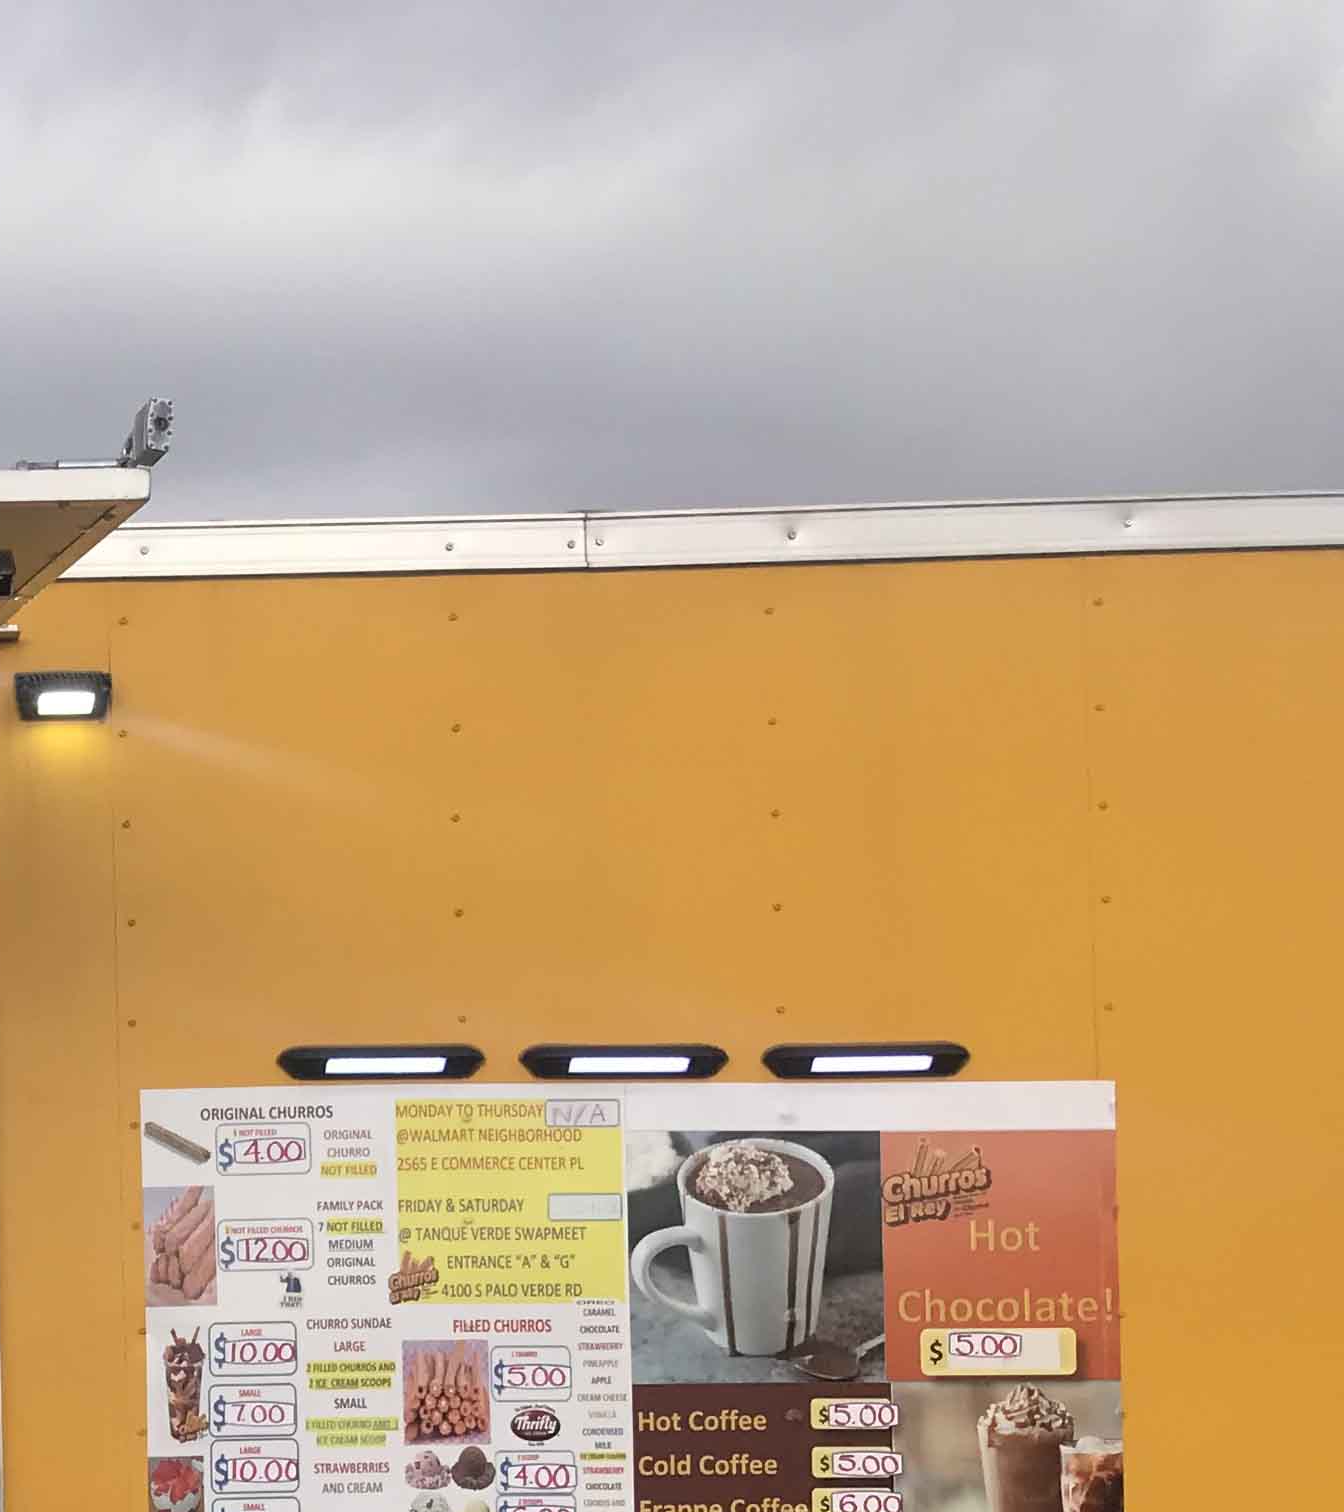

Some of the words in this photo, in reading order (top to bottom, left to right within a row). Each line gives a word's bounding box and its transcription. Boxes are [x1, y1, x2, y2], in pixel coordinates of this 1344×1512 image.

[200, 1107, 265, 1121] ORIGINAL
[269, 1105, 333, 1119] CHURROS
[396, 1105, 452, 1118] MONDAY
[457, 1105, 473, 1118] TO
[478, 1104, 544, 1118] THURSDAY
[552, 1104, 607, 1125] N/A
[323, 1130, 372, 1140] ORIGINAL
[397, 1129, 475, 1144] @WALMART
[479, 1129, 582, 1142] NEIGHBORHOOD
[327, 1148, 370, 1158] CHURRO
[397, 1158, 426, 1170] 2565
[431, 1158, 437, 1170] E
[441, 1158, 515, 1170] COMMERCE
[518, 1157, 567, 1170] CENTER
[570, 1157, 584, 1169] PL
[320, 1165, 343, 1176] NOT
[345, 1165, 377, 1175] FILLED
[882, 1167, 992, 1203] Churros
[317, 1201, 354, 1211] FAMILY
[357, 1200, 383, 1210] PACK
[398, 1200, 441, 1213] FRIDAY
[445, 1199, 455, 1212] &
[459, 1199, 524, 1212] SATURDAY
[884, 1202, 909, 1227] El
[911, 1198, 951, 1222] Rey
[326, 1222, 348, 1232] NOT
[351, 1222, 383, 1232] FILLED
[399, 1228, 411, 1243] @
[416, 1228, 467, 1242] TANQUE
[472, 1228, 511, 1241] VERDE
[515, 1227, 586, 1241] SWAPMEET
[970, 1219, 1040, 1251] Hot
[328, 1240, 373, 1250] MEDIUM
[327, 1257, 375, 1268] ORIGINAL
[447, 1256, 512, 1269] ENTRANCE
[540, 1256, 550, 1269] &
[328, 1275, 376, 1285] CHURROS
[441, 1284, 472, 1297] 4100
[475, 1284, 482, 1296] S
[486, 1284, 518, 1296] PALO
[521, 1283, 561, 1296] VERDE
[565, 1283, 582, 1296] RD
[898, 1288, 1112, 1323] Chocolate!
[306, 1319, 348, 1329] CHURRO
[351, 1318, 392, 1329] SUNDAE
[453, 1320, 490, 1333] FILLED
[494, 1319, 552, 1332] CHURROS
[580, 1326, 620, 1334] CHOCOLATE
[334, 1341, 366, 1352] LARGE
[379, 1361, 395, 1371] AND
[361, 1378, 391, 1387] SCOOPS
[334, 1398, 367, 1409] SMALL
[638, 1411, 683, 1432] Hot
[689, 1411, 768, 1431] Coffee
[314, 1462, 390, 1474] STRAWBERRIES
[638, 1455, 696, 1477] Cold
[702, 1455, 778, 1475] Coffee
[322, 1484, 344, 1494] AND
[347, 1483, 383, 1493] CREAM
